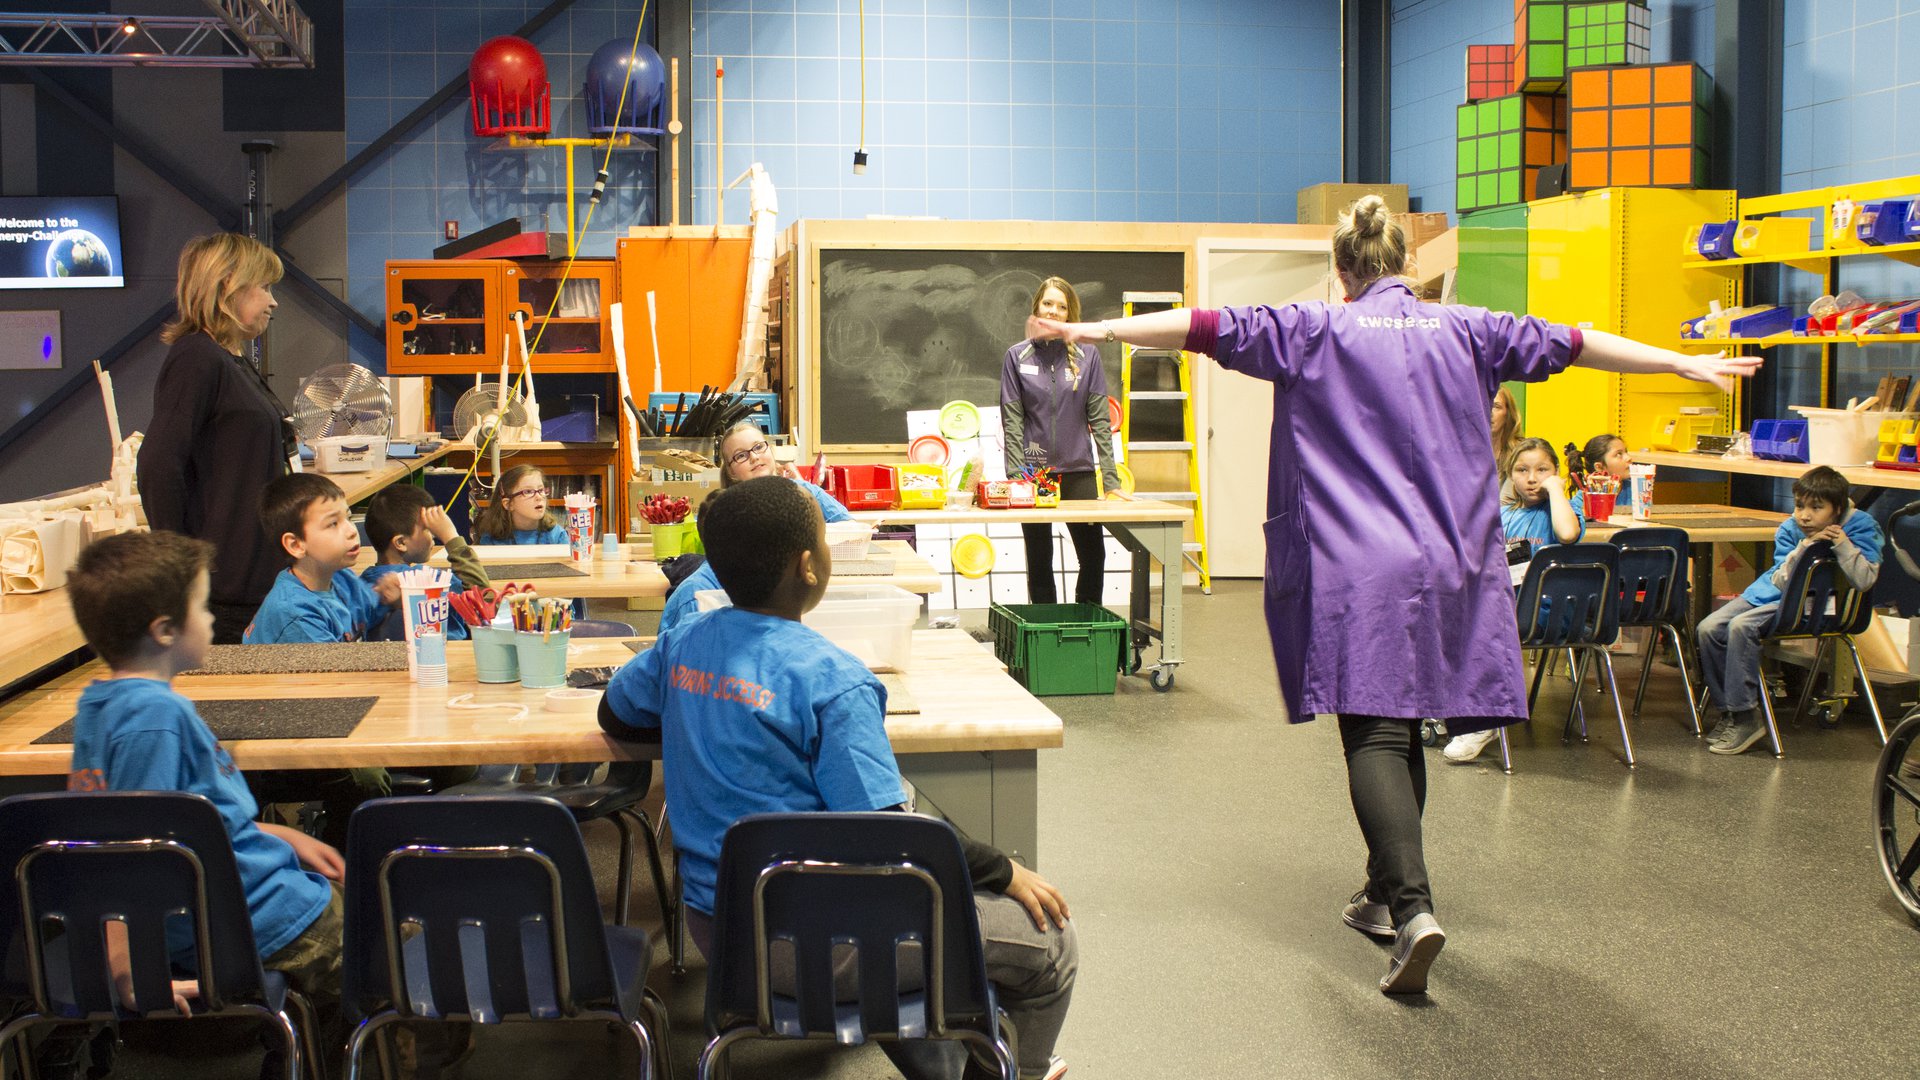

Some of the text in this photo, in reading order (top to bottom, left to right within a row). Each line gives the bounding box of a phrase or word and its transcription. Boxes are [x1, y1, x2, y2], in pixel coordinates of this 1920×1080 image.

[0, 217, 78, 228] Welcome to the
[0, 230, 85, 243] nergy-Challenge
[1357, 315, 1441, 330] twose.ca
[417, 597, 450, 625] ICE
